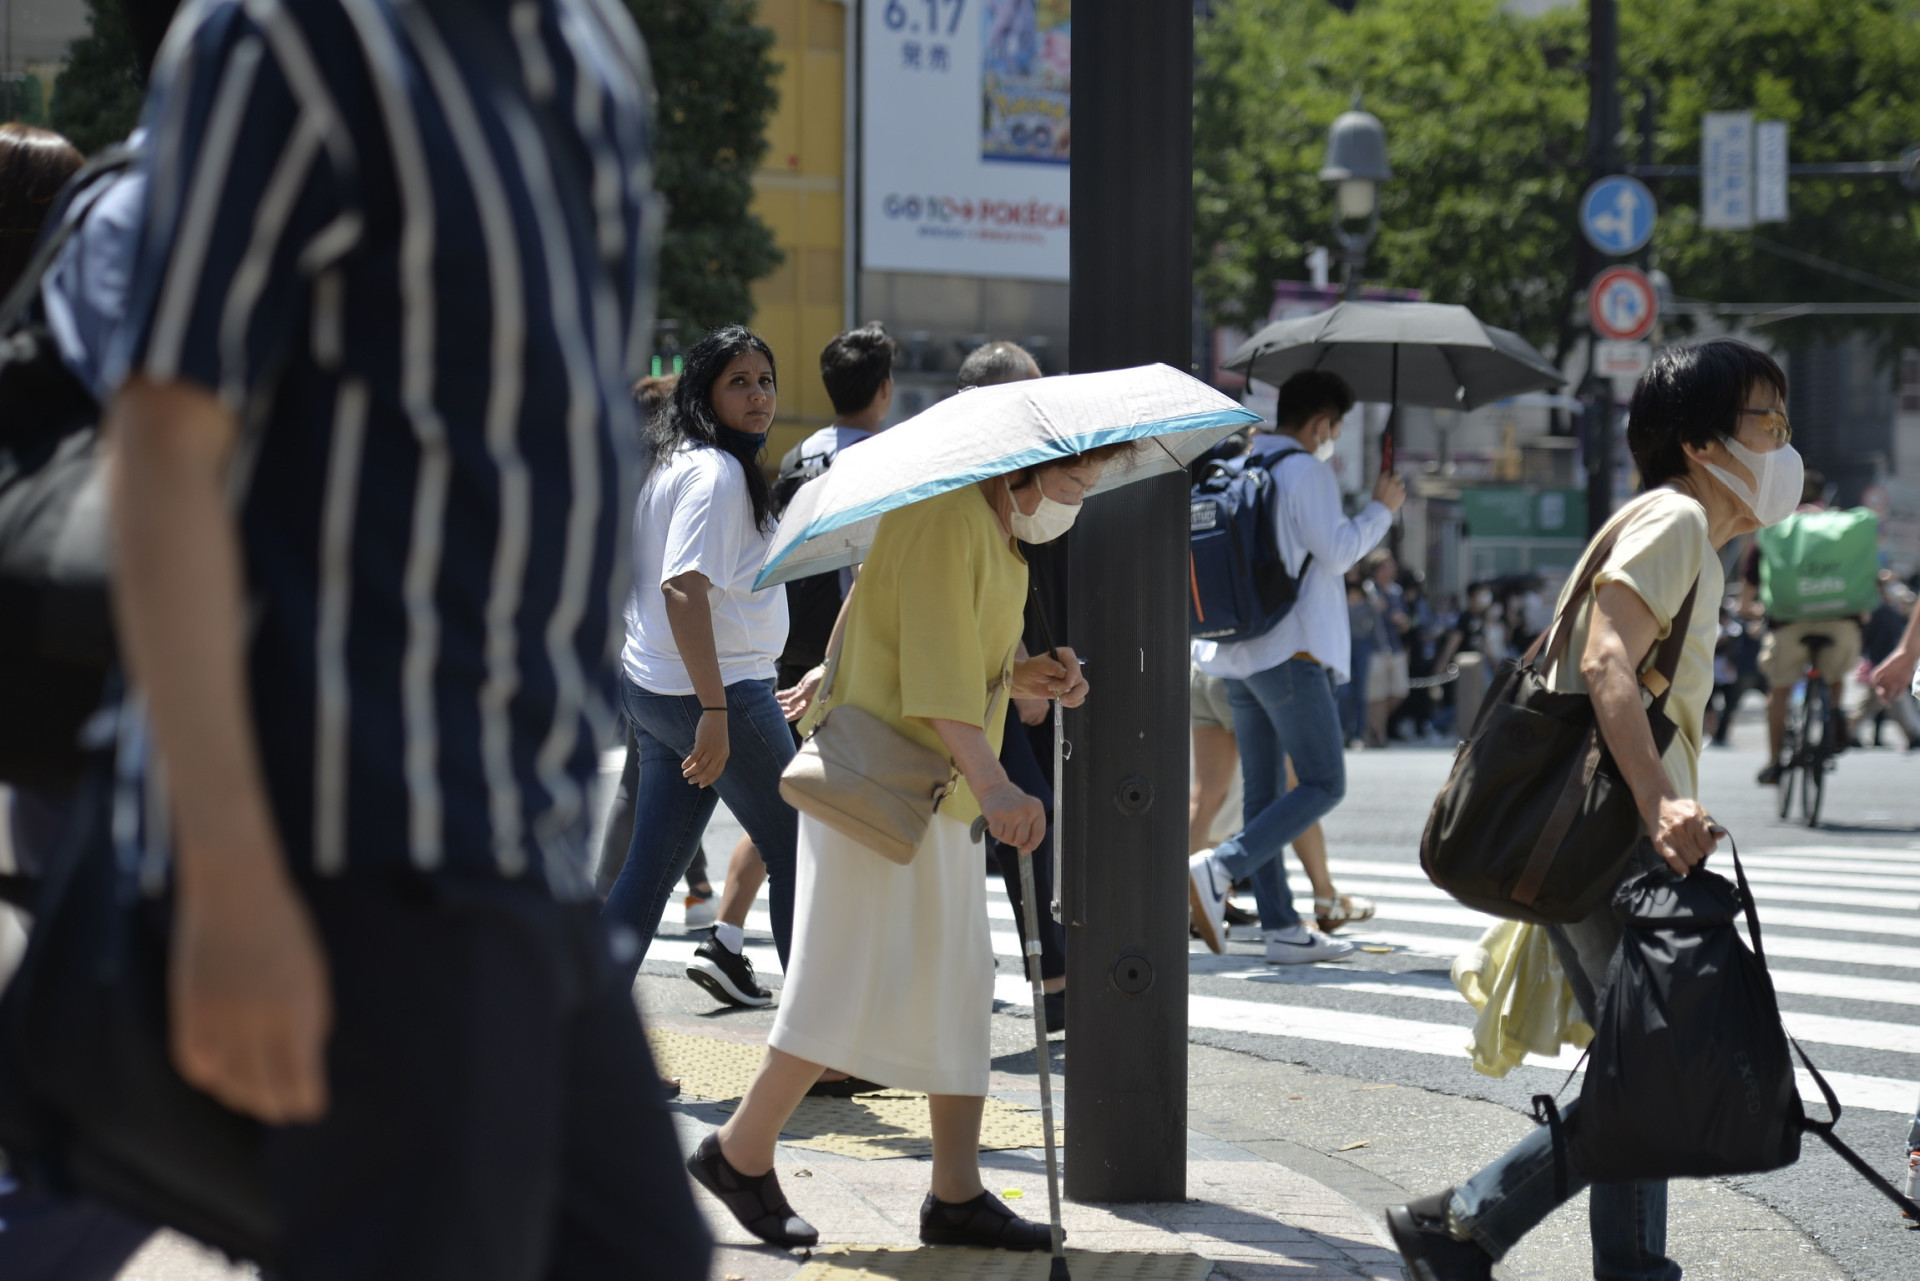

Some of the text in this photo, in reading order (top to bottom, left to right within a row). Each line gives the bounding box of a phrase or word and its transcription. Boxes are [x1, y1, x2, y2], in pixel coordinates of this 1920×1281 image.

[884, 0, 965, 35] 6.17
[902, 41, 949, 71] 発売
[1733, 1051, 1760, 1114] EXPED
